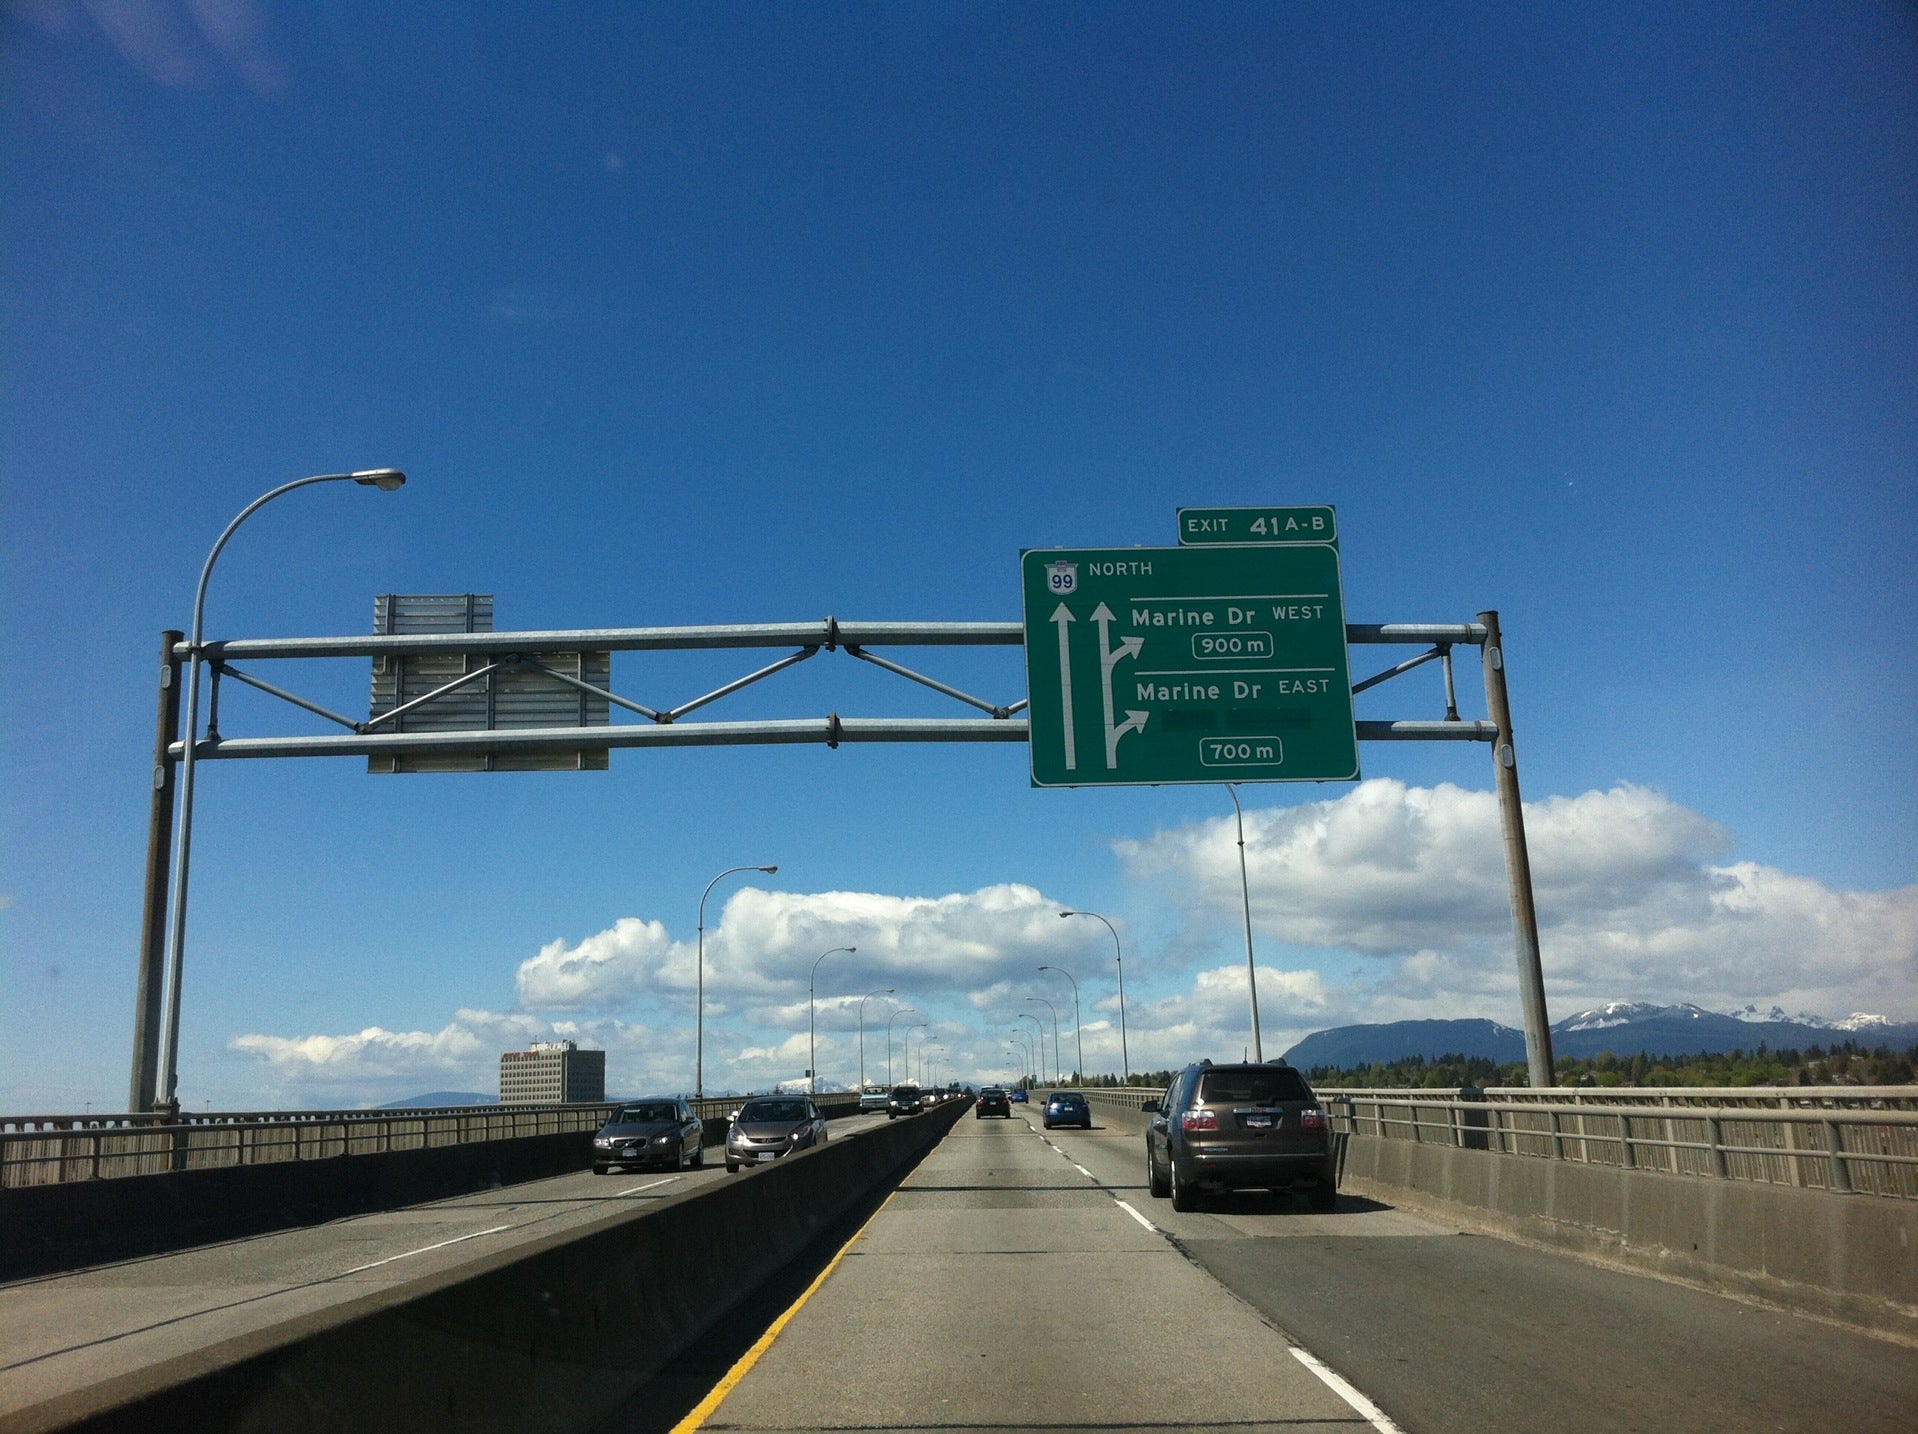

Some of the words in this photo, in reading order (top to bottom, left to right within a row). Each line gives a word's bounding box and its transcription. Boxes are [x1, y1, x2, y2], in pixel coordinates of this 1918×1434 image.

[1188, 519, 1229, 532] EXIT
[1089, 562, 1152, 576] NORTH
[1051, 574, 1073, 589] 99
[1132, 608, 1214, 627] Marine
[1228, 607, 1255, 625] Dr
[1272, 605, 1324, 620] WEST
[1201, 637, 1241, 653] 900
[1137, 682, 1220, 701] Marine
[1234, 681, 1261, 699] Dr
[1279, 679, 1329, 694] EAST
[1210, 744, 1251, 759] 700
